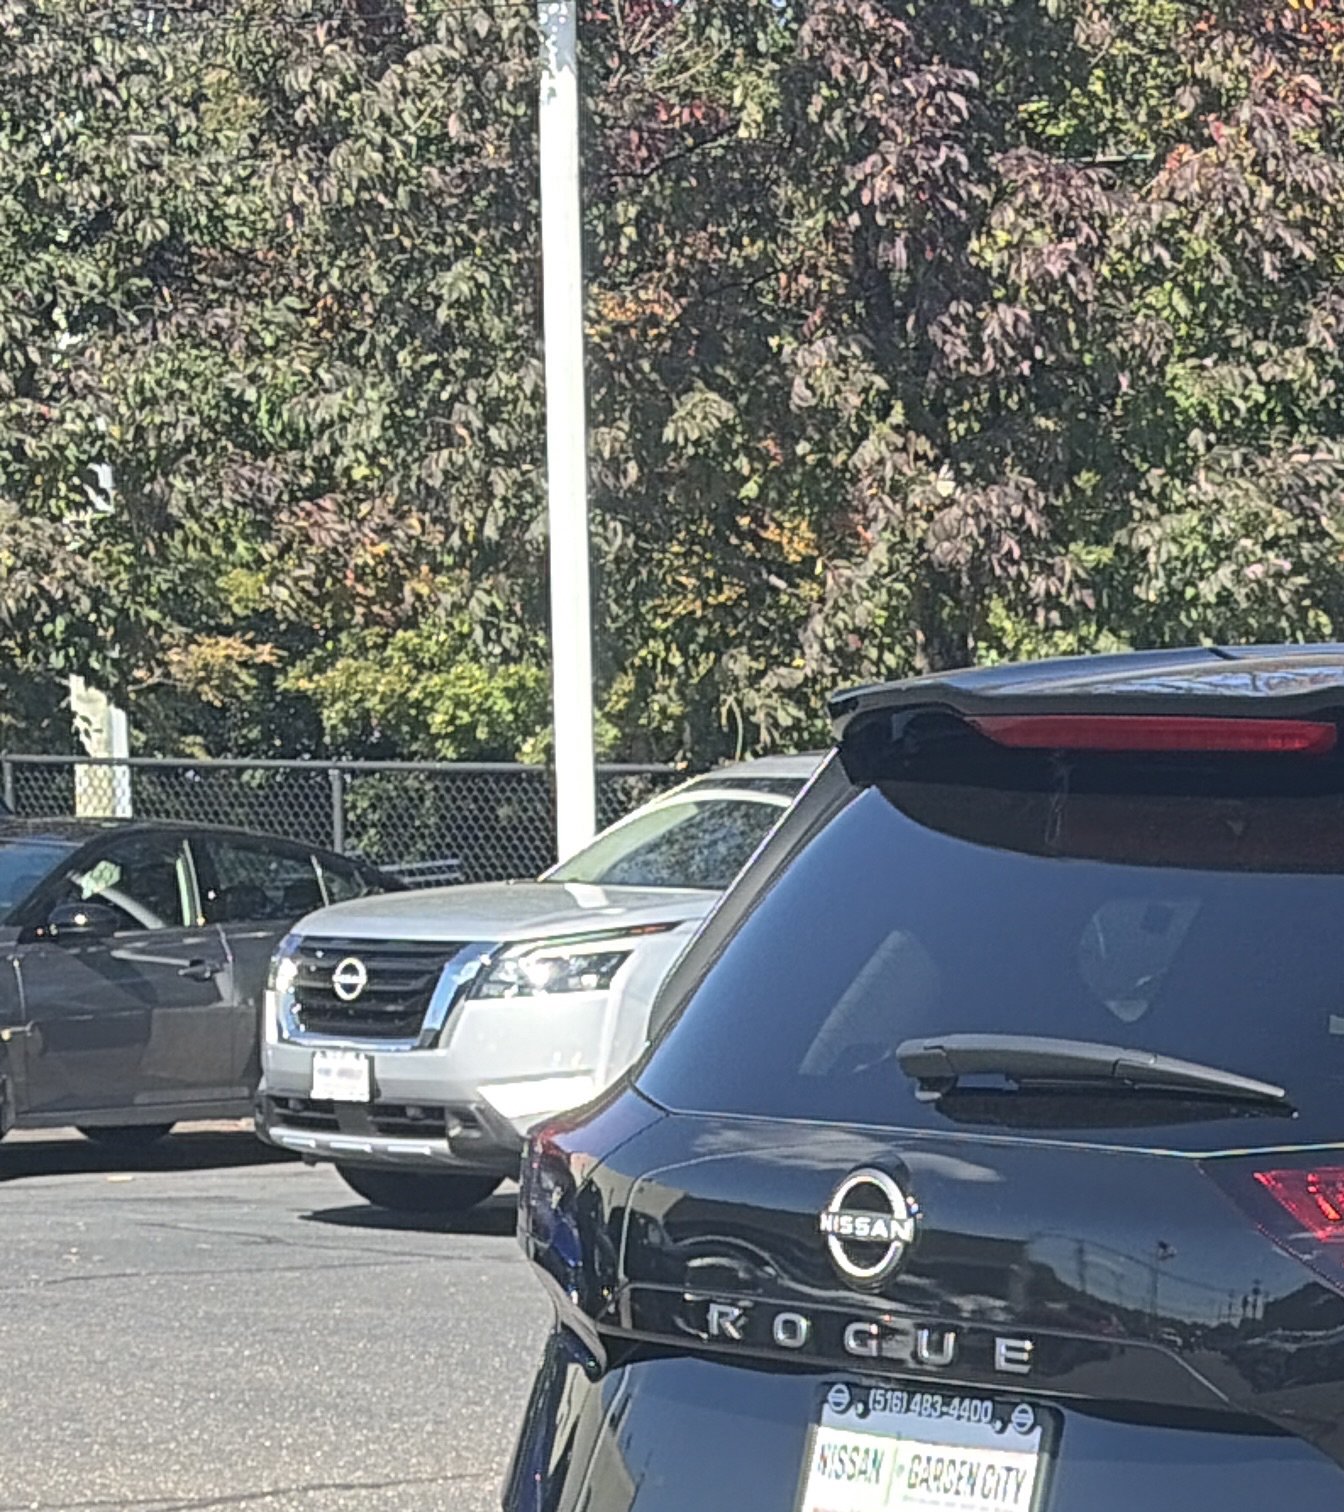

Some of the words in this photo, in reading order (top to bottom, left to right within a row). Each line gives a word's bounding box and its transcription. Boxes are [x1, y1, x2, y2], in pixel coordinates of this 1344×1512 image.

[820, 1213, 914, 1243] NISSAN
[708, 1304, 1033, 1374] ROGUE
[869, 1389, 907, 1413] (516)
[910, 1393, 993, 1422] 483-4400
[817, 1442, 884, 1485] NISSAN
[907, 1453, 978, 1497] GARDEN
[982, 1464, 1027, 1504] CITY
